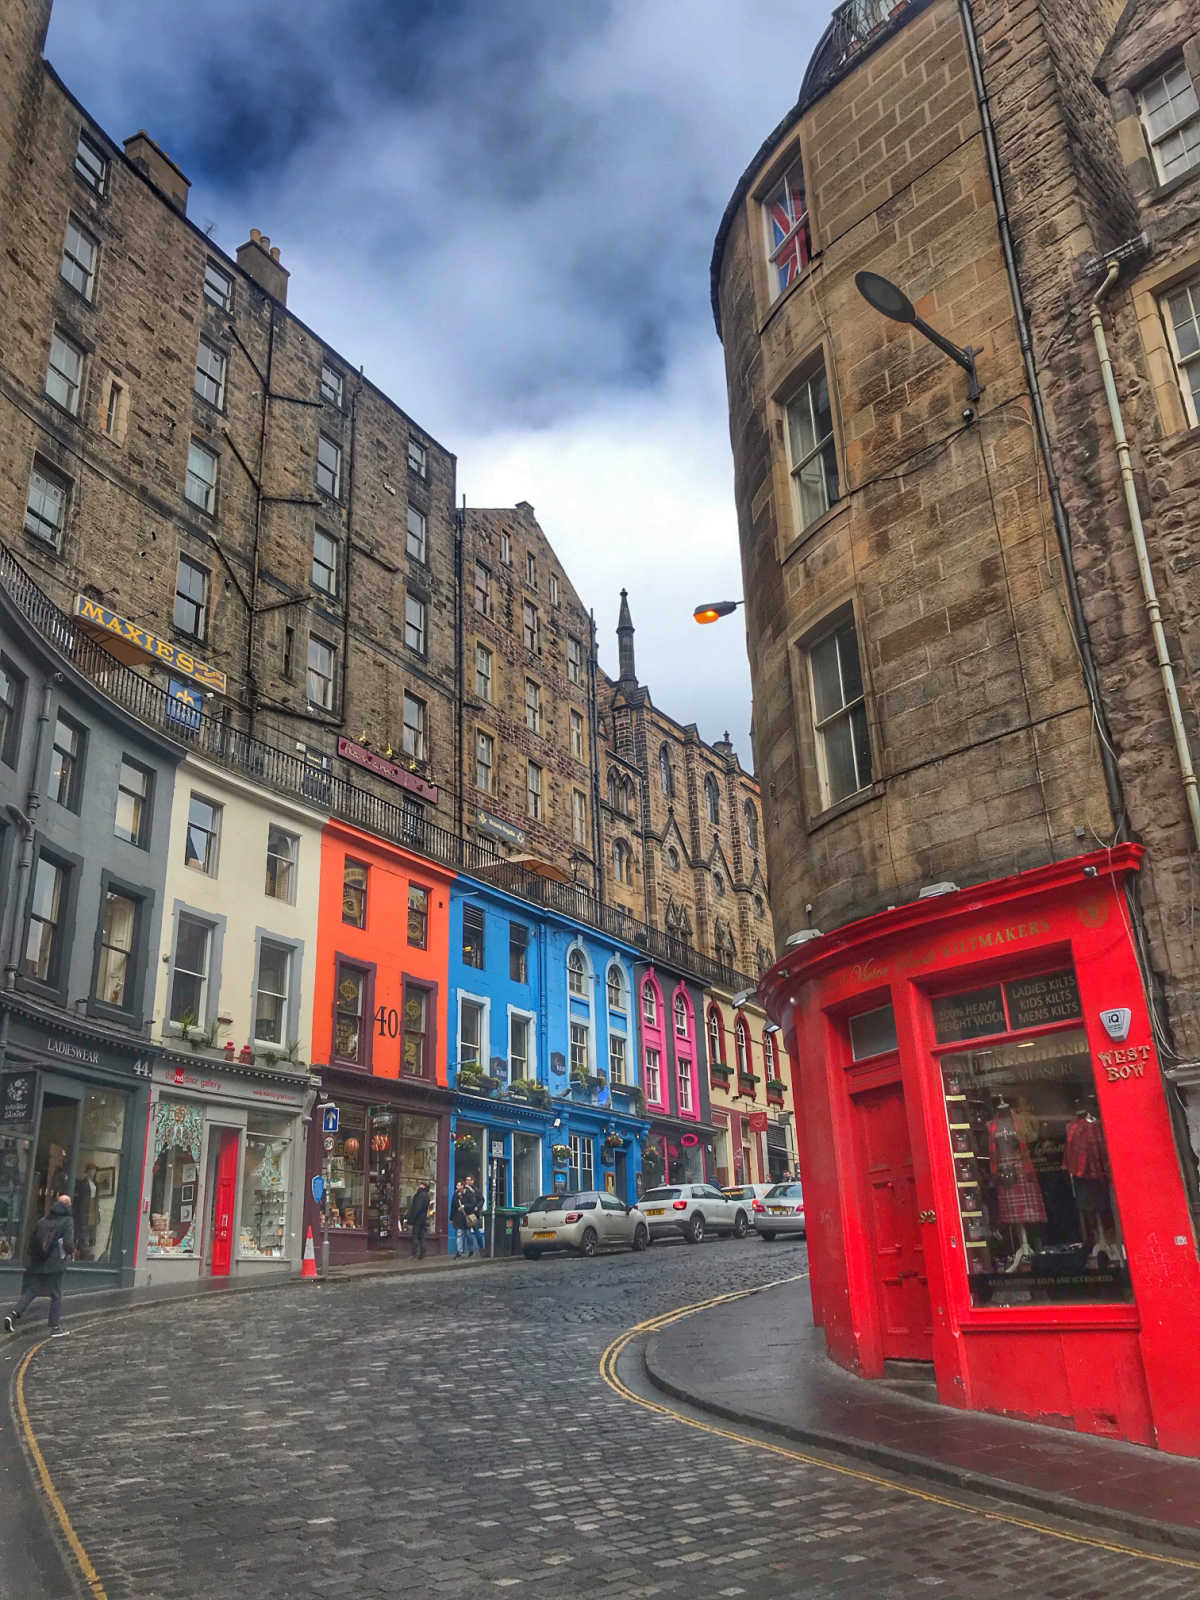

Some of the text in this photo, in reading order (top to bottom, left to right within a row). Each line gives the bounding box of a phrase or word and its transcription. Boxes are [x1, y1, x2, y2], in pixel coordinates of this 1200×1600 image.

[81, 600, 194, 672] MAXIES
[942, 918, 1051, 959] KILTMAKERS
[1012, 975, 1076, 999] LADIES KILTS
[966, 999, 998, 1015] HEAVY
[1020, 989, 1072, 1010] KIDS KILTS
[375, 1006, 398, 1038] 40
[974, 1010, 1006, 1026] WOOL
[1018, 1002, 1080, 1025] MENS KILTS
[47, 1038, 100, 1064] LADIESWEAR
[1097, 1045, 1151, 1067] WEST
[1105, 1061, 1146, 1082] BOW
